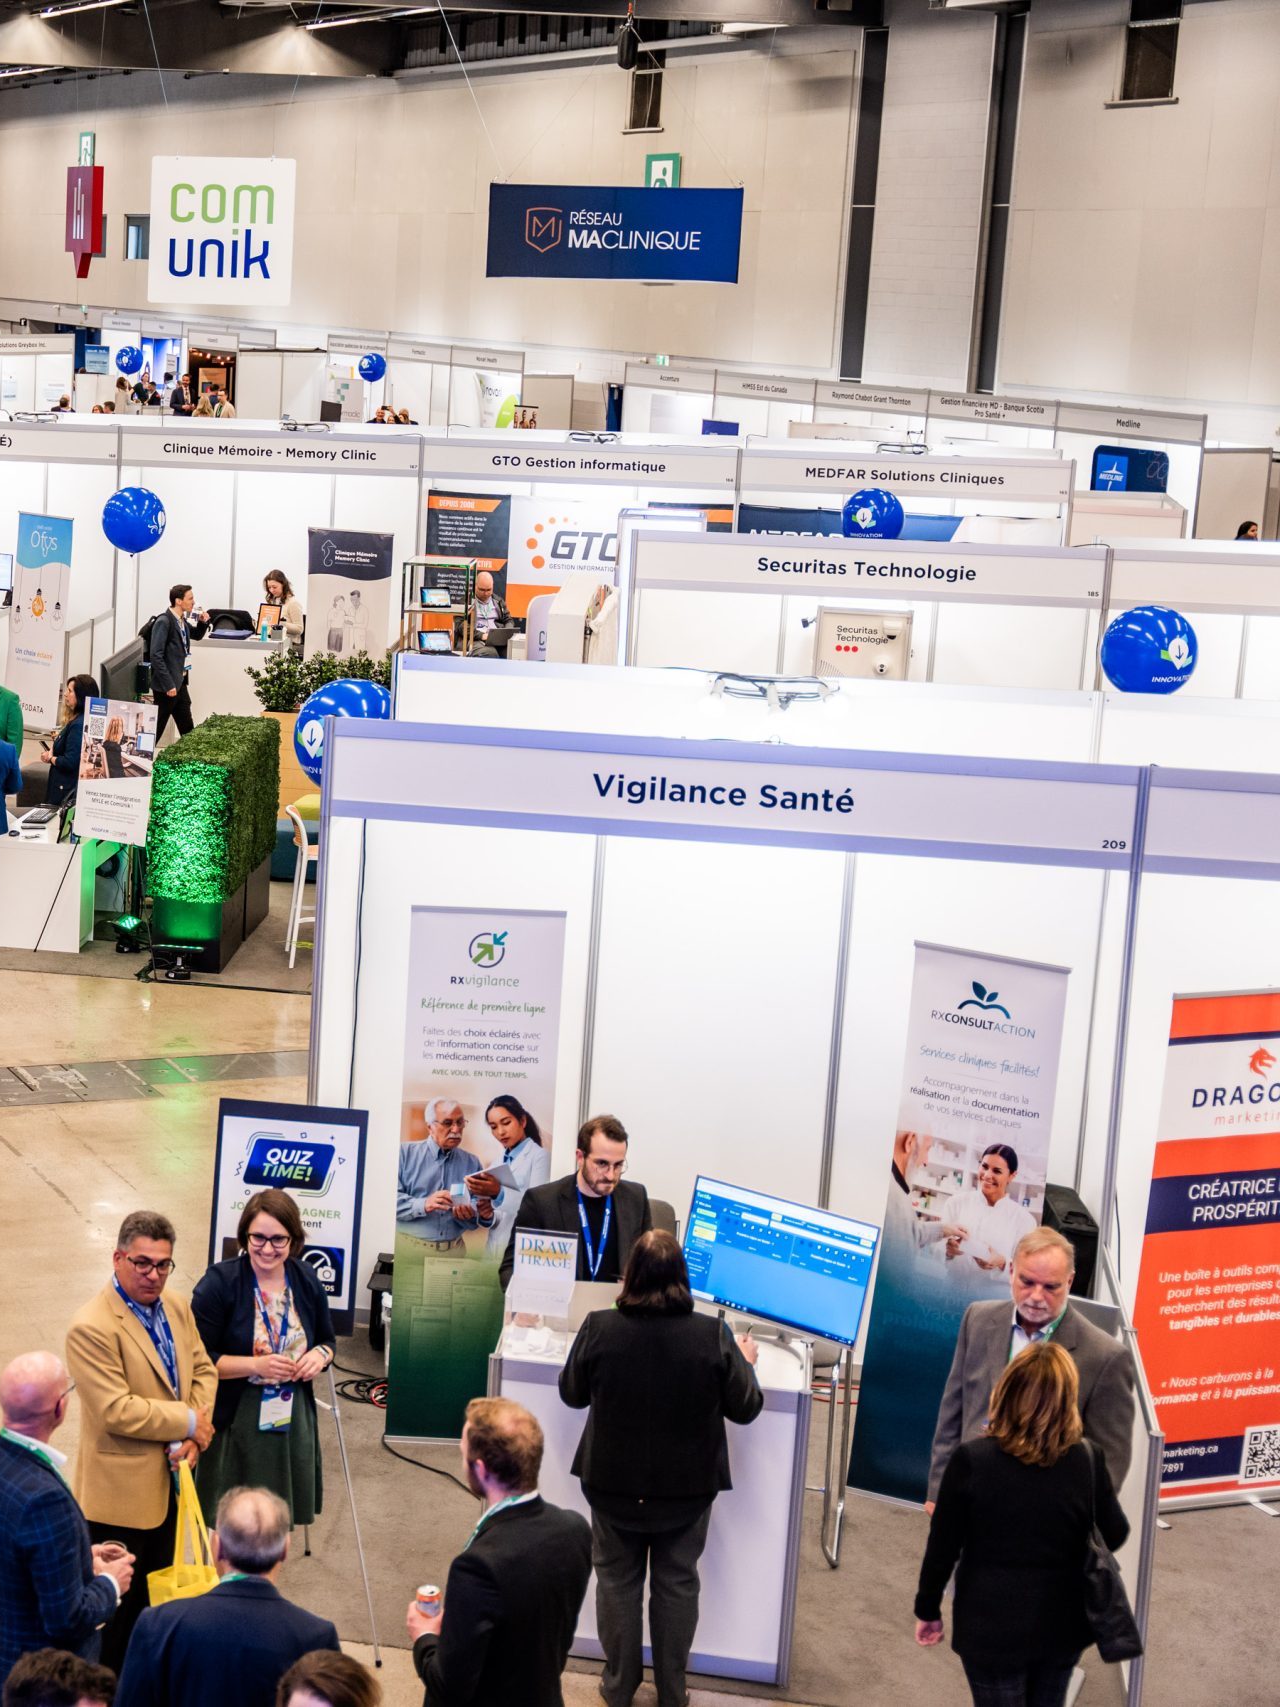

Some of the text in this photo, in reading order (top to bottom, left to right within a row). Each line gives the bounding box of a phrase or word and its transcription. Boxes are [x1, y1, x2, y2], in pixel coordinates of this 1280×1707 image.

[171, 183, 274, 224] com
[569, 209, 622, 226] RÉSEAU
[568, 230, 702, 250] MACLINIQUE
[169, 229, 270, 278] unik
[660, 375, 679, 383] Accenture
[742, 383, 787, 394] HIMSS Canada
[832, 391, 911, 406] Raymond Chabot Grant Thornton
[940, 397, 960, 406] Gestion
[961, 398, 989, 408] financière
[1003, 403, 1025, 413] Banque
[1026, 404, 1044, 414] Scotia
[974, 409, 1001, 419] Pro Santé
[1116, 418, 1141, 429] Medline
[163, 443, 377, 461] Clinique Mémoire Memory Clinic
[492, 456, 666, 473] GTO Gestion informatique
[805, 467, 1005, 486] MEDFAR Solutions Cliniques
[1099, 473, 1123, 482] MEDLINE
[439, 499, 458, 508] DEPUIS
[31, 530, 58, 557] Ofys
[549, 563, 576, 571] GESTION
[757, 557, 977, 583] Securitas Technologie
[836, 625, 878, 636] Securitas
[836, 634, 889, 646] Technologie
[592, 773, 856, 814] Vigilance Santé
[1102, 839, 1127, 850] 209
[450, 975, 520, 988] RXvigilance
[421, 997, 546, 1017] Référence de première ligne
[423, 1027, 445, 1036] Faites
[447, 1027, 461, 1036] des
[464, 1028, 486, 1037] choix
[489, 1029, 520, 1039] éclairés
[931, 1010, 1036, 1039] RXCONSULTACTION
[437, 1040, 490, 1050] l'information
[493, 1042, 525, 1051] concise
[423, 1051, 539, 1064] les médicaments canadiens
[920, 1045, 1040, 1078] Services cliniques facilités!
[504, 1071, 528, 1079] TEMPS.
[923, 1076, 1029, 1105] Accompagnement dans la
[1192, 1082, 1280, 1108] DRAGO
[910, 1086, 1040, 1119] réalisation et la documentation
[924, 1102, 1022, 1129] de vos services cliniques
[266, 1147, 314, 1166] QUIZ
[262, 1162, 313, 1182] TIME!
[1188, 1177, 1276, 1200] CRÉATRICE
[1192, 1199, 1280, 1223] PROSPÉRIT
[521, 1237, 573, 1255] DRAW
[521, 1253, 571, 1269] TIRAGE
[1158, 1265, 1253, 1283] Une boîte à outils
[1167, 1279, 1273, 1301] pour les entreprises
[1160, 1297, 1246, 1315] recherchent des
[1169, 1309, 1280, 1331] tangibles et durables
[1170, 1367, 1274, 1389] Nous carburons à la
[1201, 1386, 1232, 1400] et la
